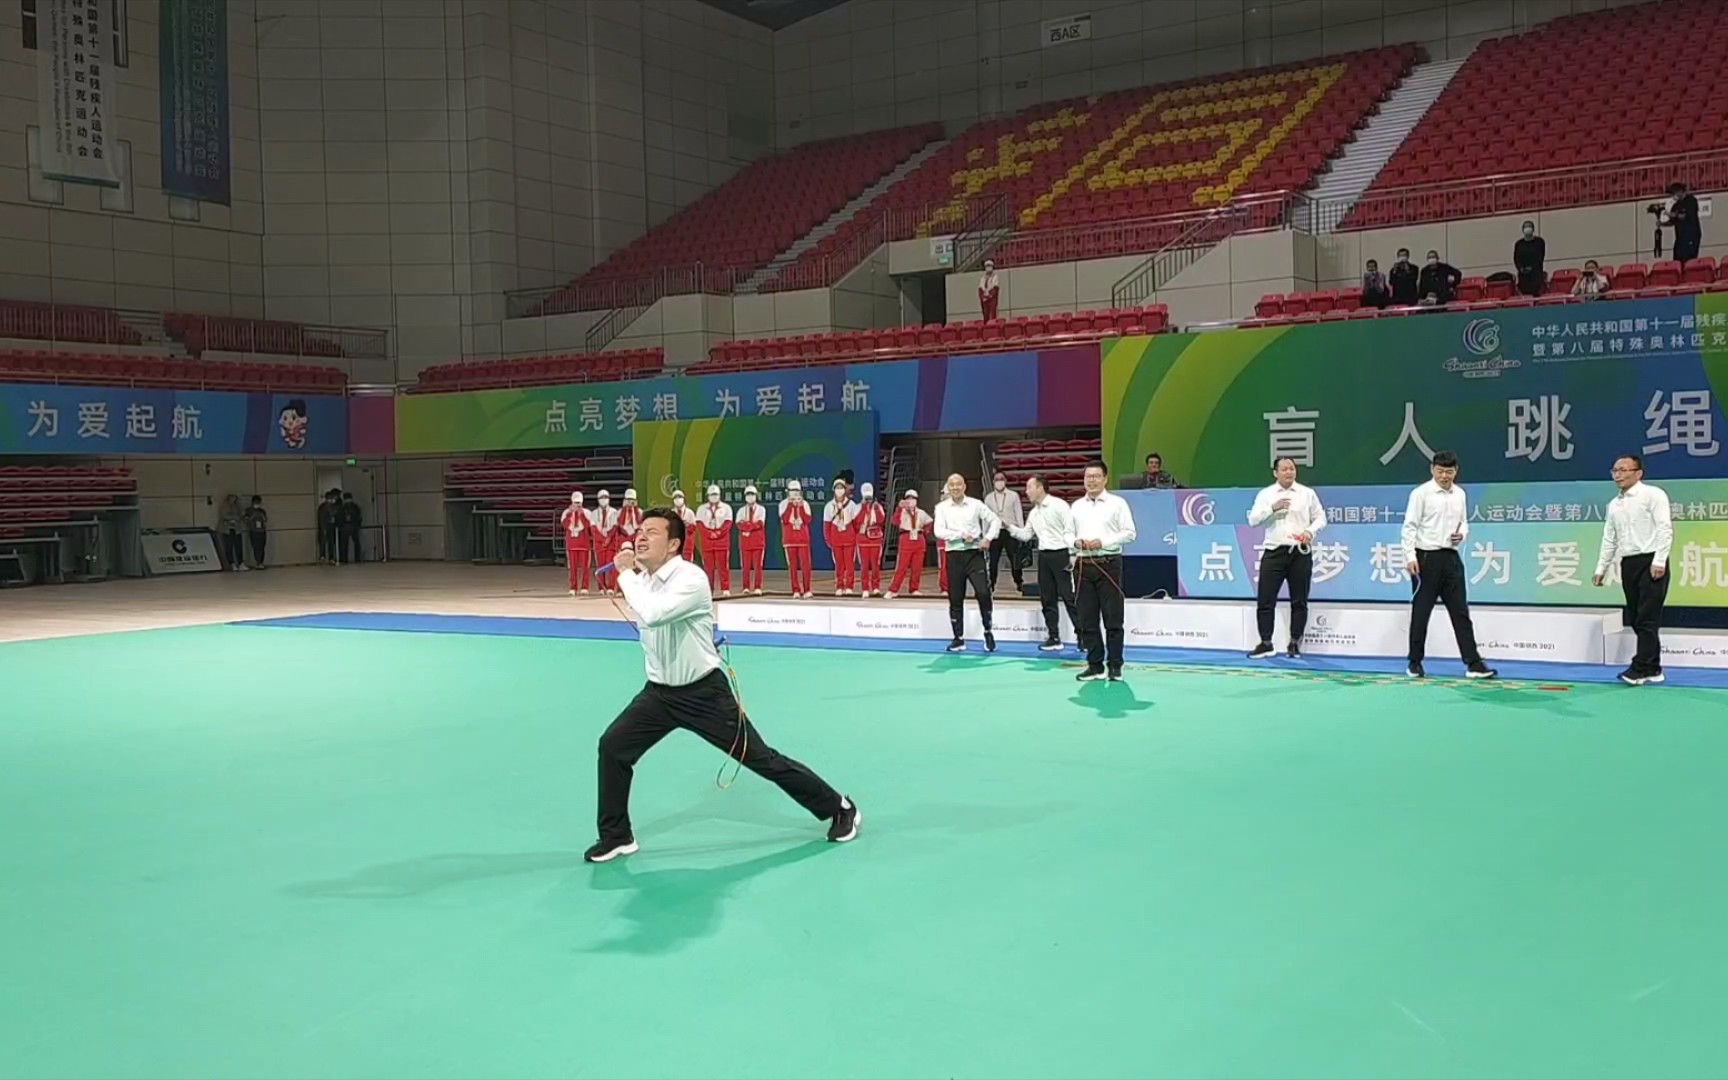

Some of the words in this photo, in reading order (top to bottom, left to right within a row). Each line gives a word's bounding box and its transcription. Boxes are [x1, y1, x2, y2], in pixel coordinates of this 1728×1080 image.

[1050, 24, 1081, 42] 西A区
[1532, 332, 1727, 357] 暨第八届特殊奥林匹克
[27, 401, 203, 440] 为爱起航
[544, 393, 678, 433] 点亮梦想
[715, 380, 872, 418] 为爱起航
[1263, 389, 1720, 468] 盲人跳绳
[1470, 541, 1728, 588] 为爱航
